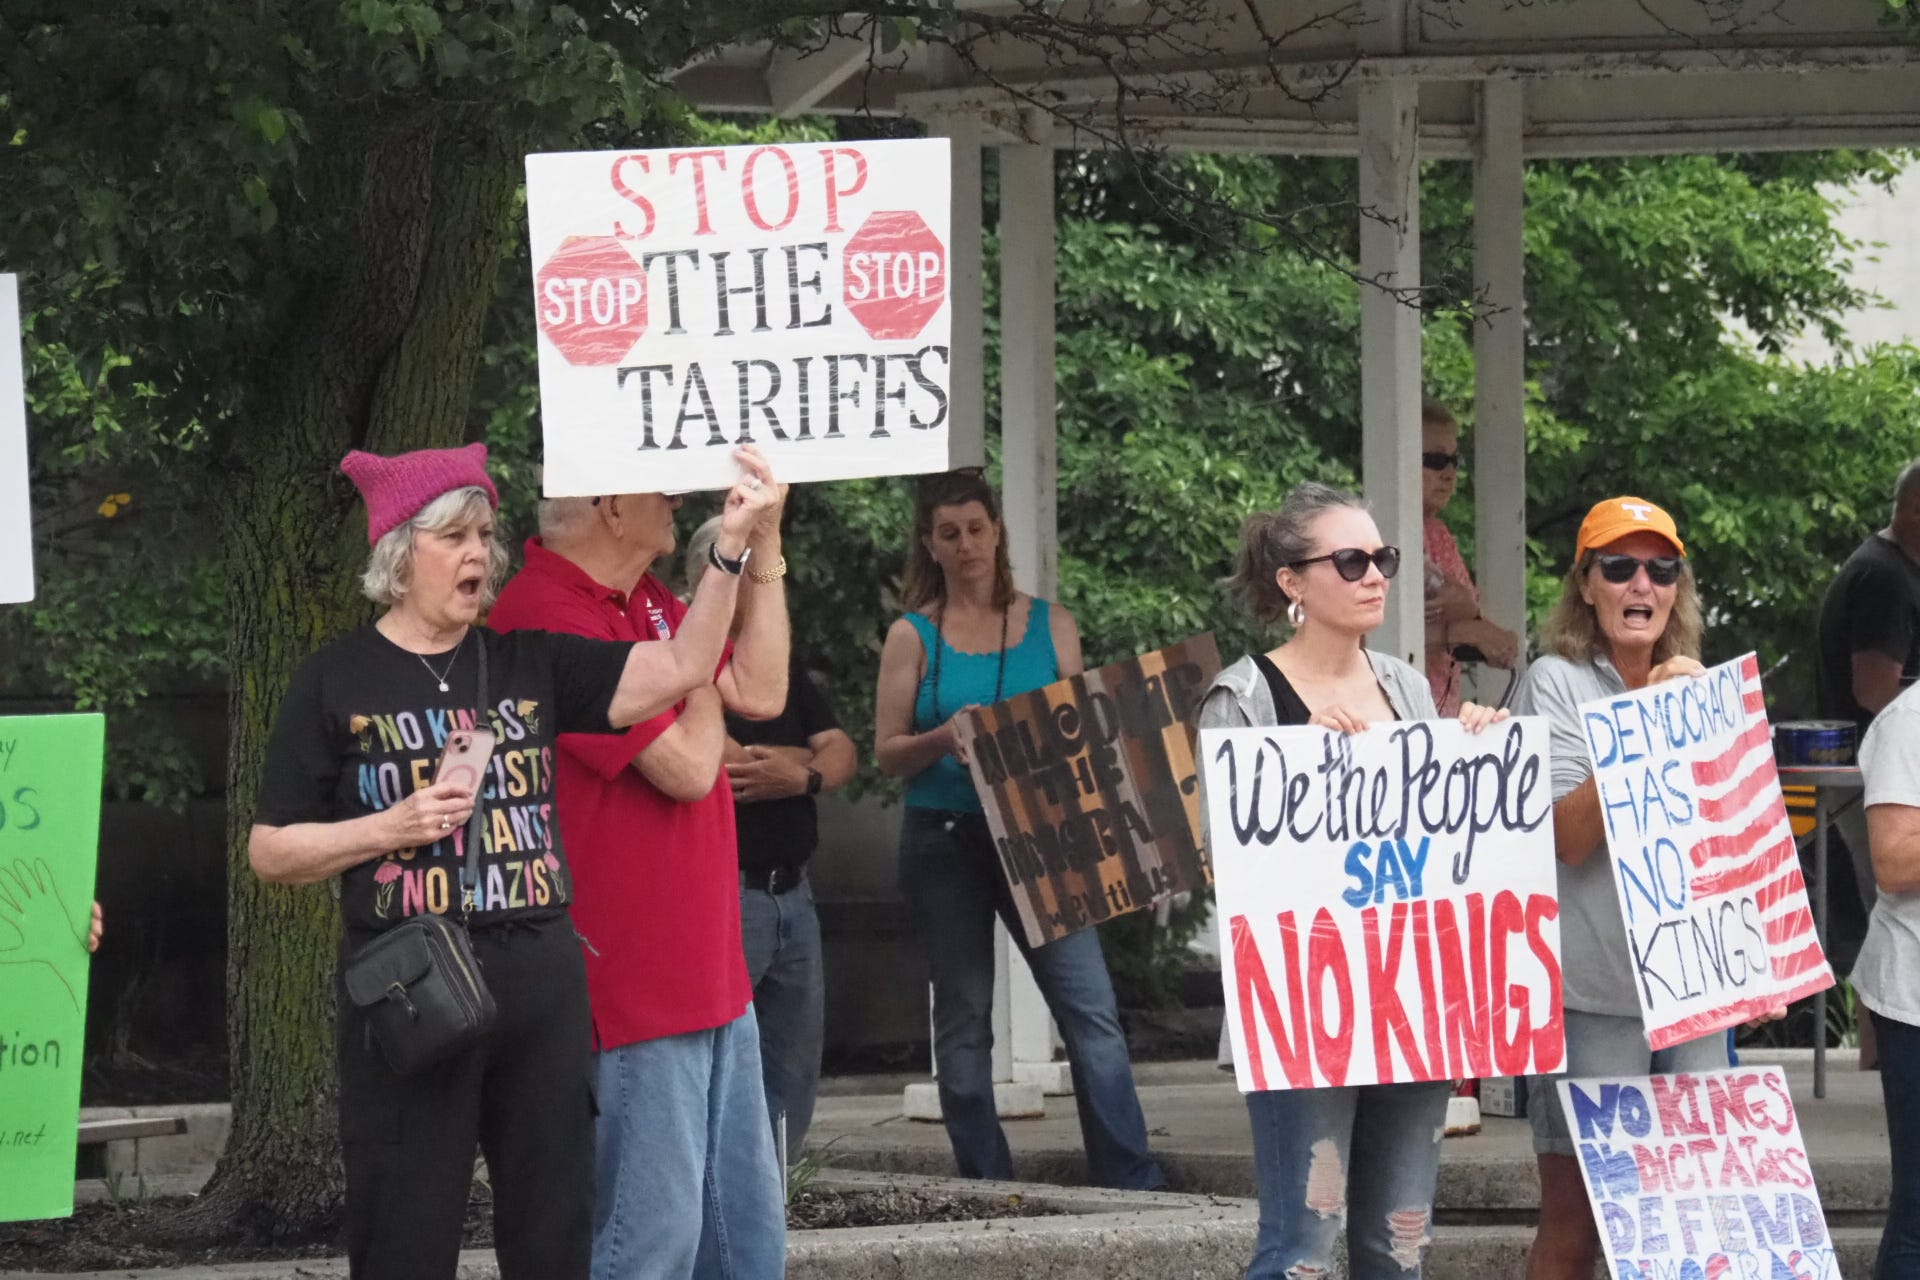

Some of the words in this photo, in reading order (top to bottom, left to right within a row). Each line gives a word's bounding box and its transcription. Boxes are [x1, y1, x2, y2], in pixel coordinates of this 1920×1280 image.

[610, 146, 868, 240] STOP
[543, 277, 642, 325] STOP
[642, 242, 832, 336] THE
[848, 251, 940, 300] STOP
[616, 345, 949, 451] TARIFFS
[372, 711, 424, 753] NO
[1584, 662, 1746, 768] DEMOCRACY
[358, 762, 404, 811] NO
[1215, 736, 1324, 846] We
[1317, 731, 1399, 841] the
[1389, 721, 1552, 885] People
[1600, 760, 1693, 842] HAS
[402, 867, 449, 917] NO
[1341, 836, 1431, 908] SAY
[1617, 837, 1686, 924] NO
[1229, 906, 1355, 1092] NO
[1361, 889, 1565, 1084] KINGS
[1629, 897, 1767, 1010] KINGS
[1568, 1081, 1652, 1139] NO
[1650, 1072, 1795, 1137] KINGS
[1600, 1193, 1826, 1256] DEFEND
